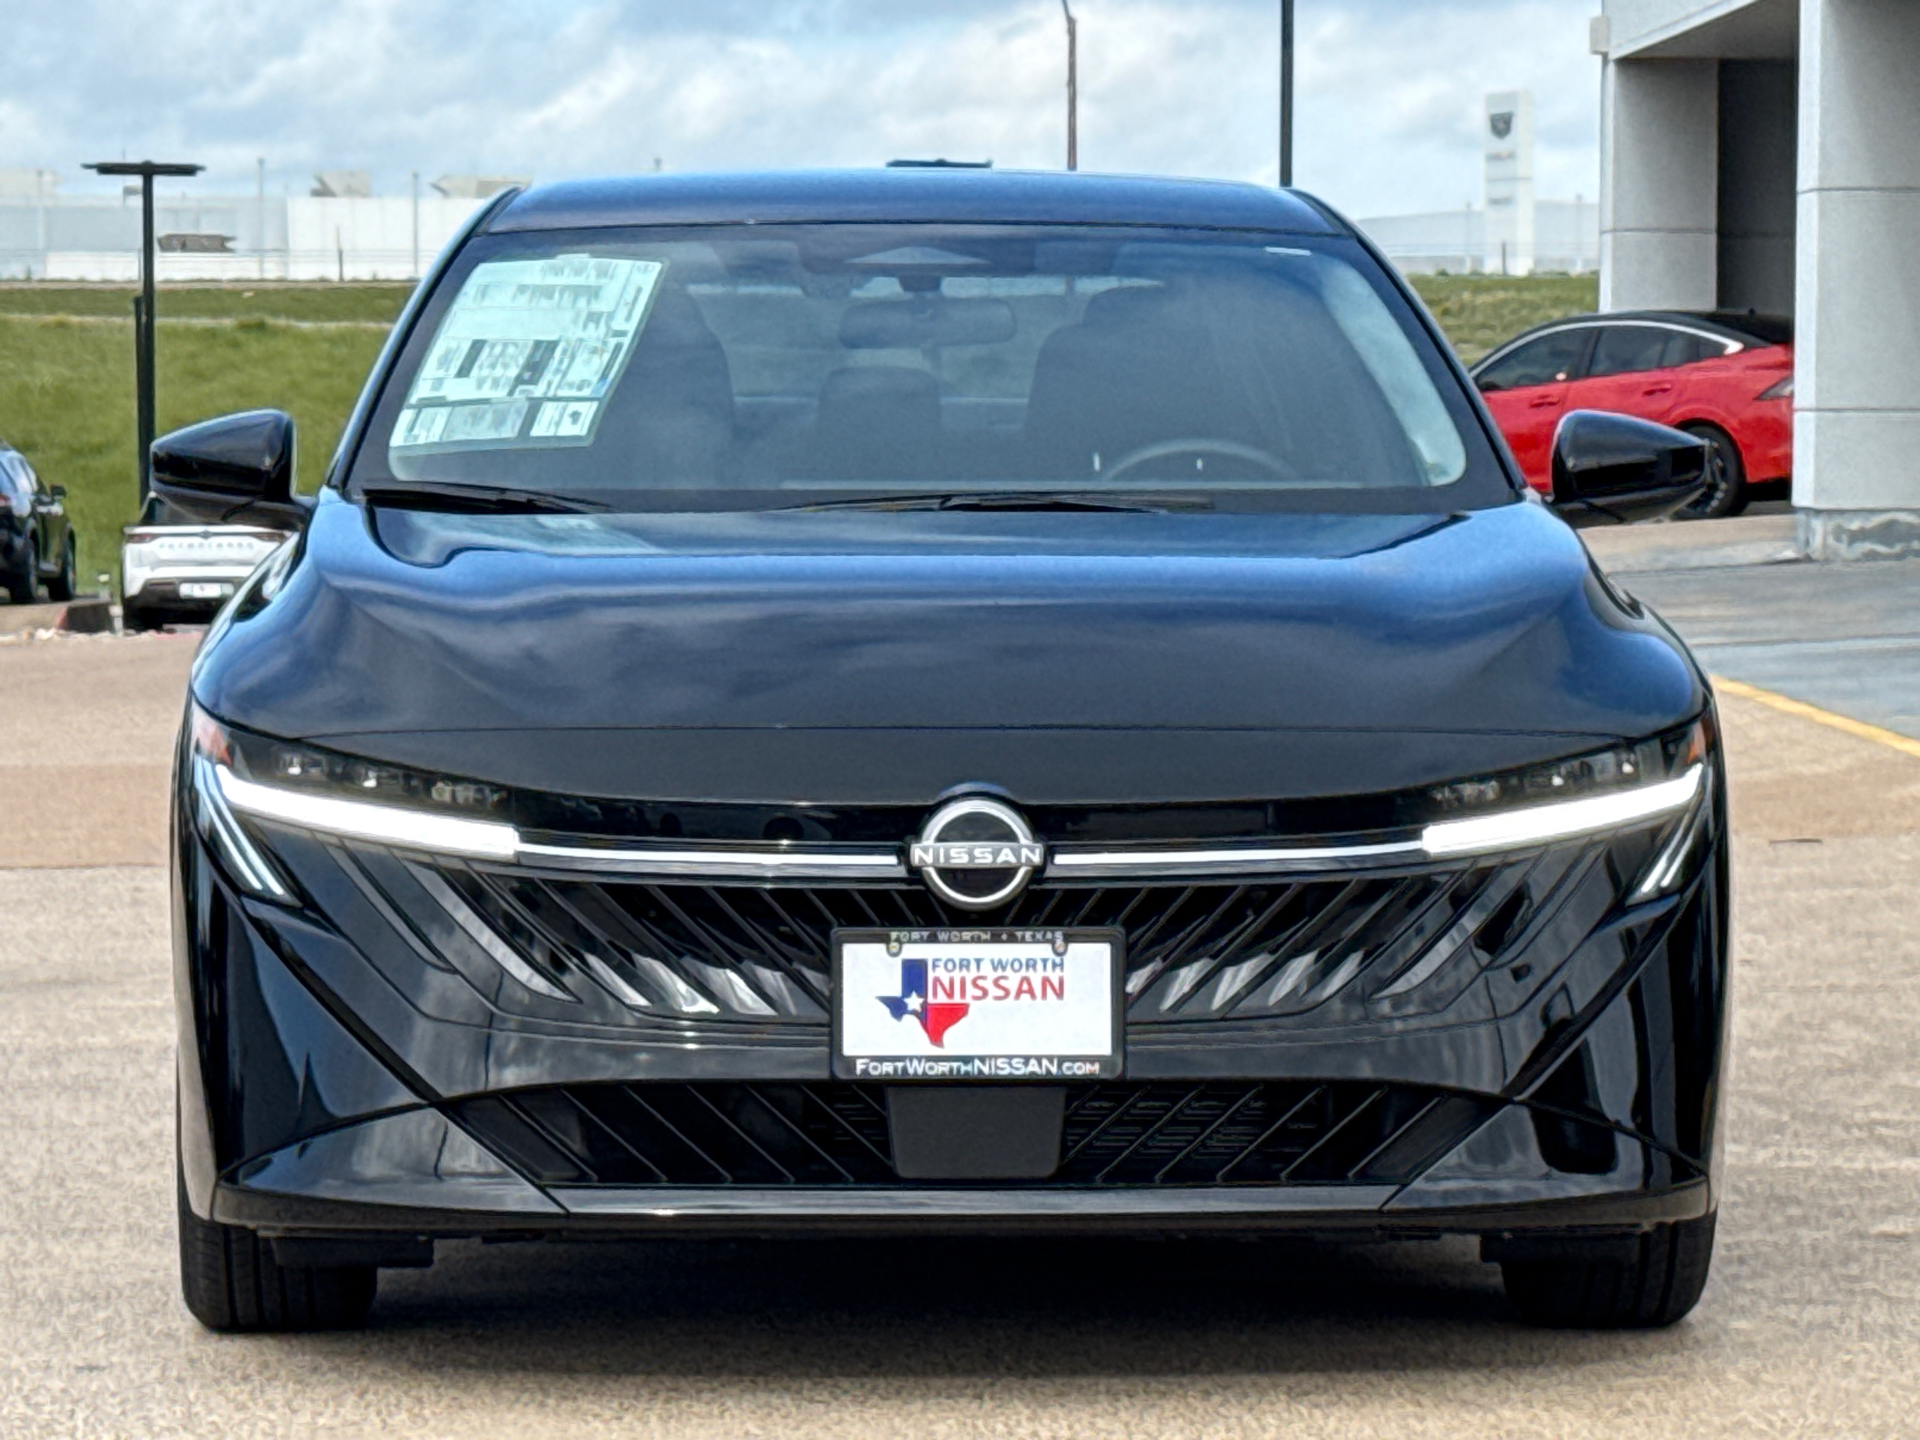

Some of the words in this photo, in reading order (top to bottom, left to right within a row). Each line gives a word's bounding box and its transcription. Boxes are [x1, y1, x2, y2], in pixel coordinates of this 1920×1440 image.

[913, 846, 1042, 865] NISSAN
[889, 931, 930, 942] FORT
[937, 931, 991, 942] WORTH
[1015, 931, 1064, 942] TEXAS
[931, 957, 985, 973] FORT
[990, 957, 1065, 973] WORTH
[931, 975, 1065, 1001] NISSAN
